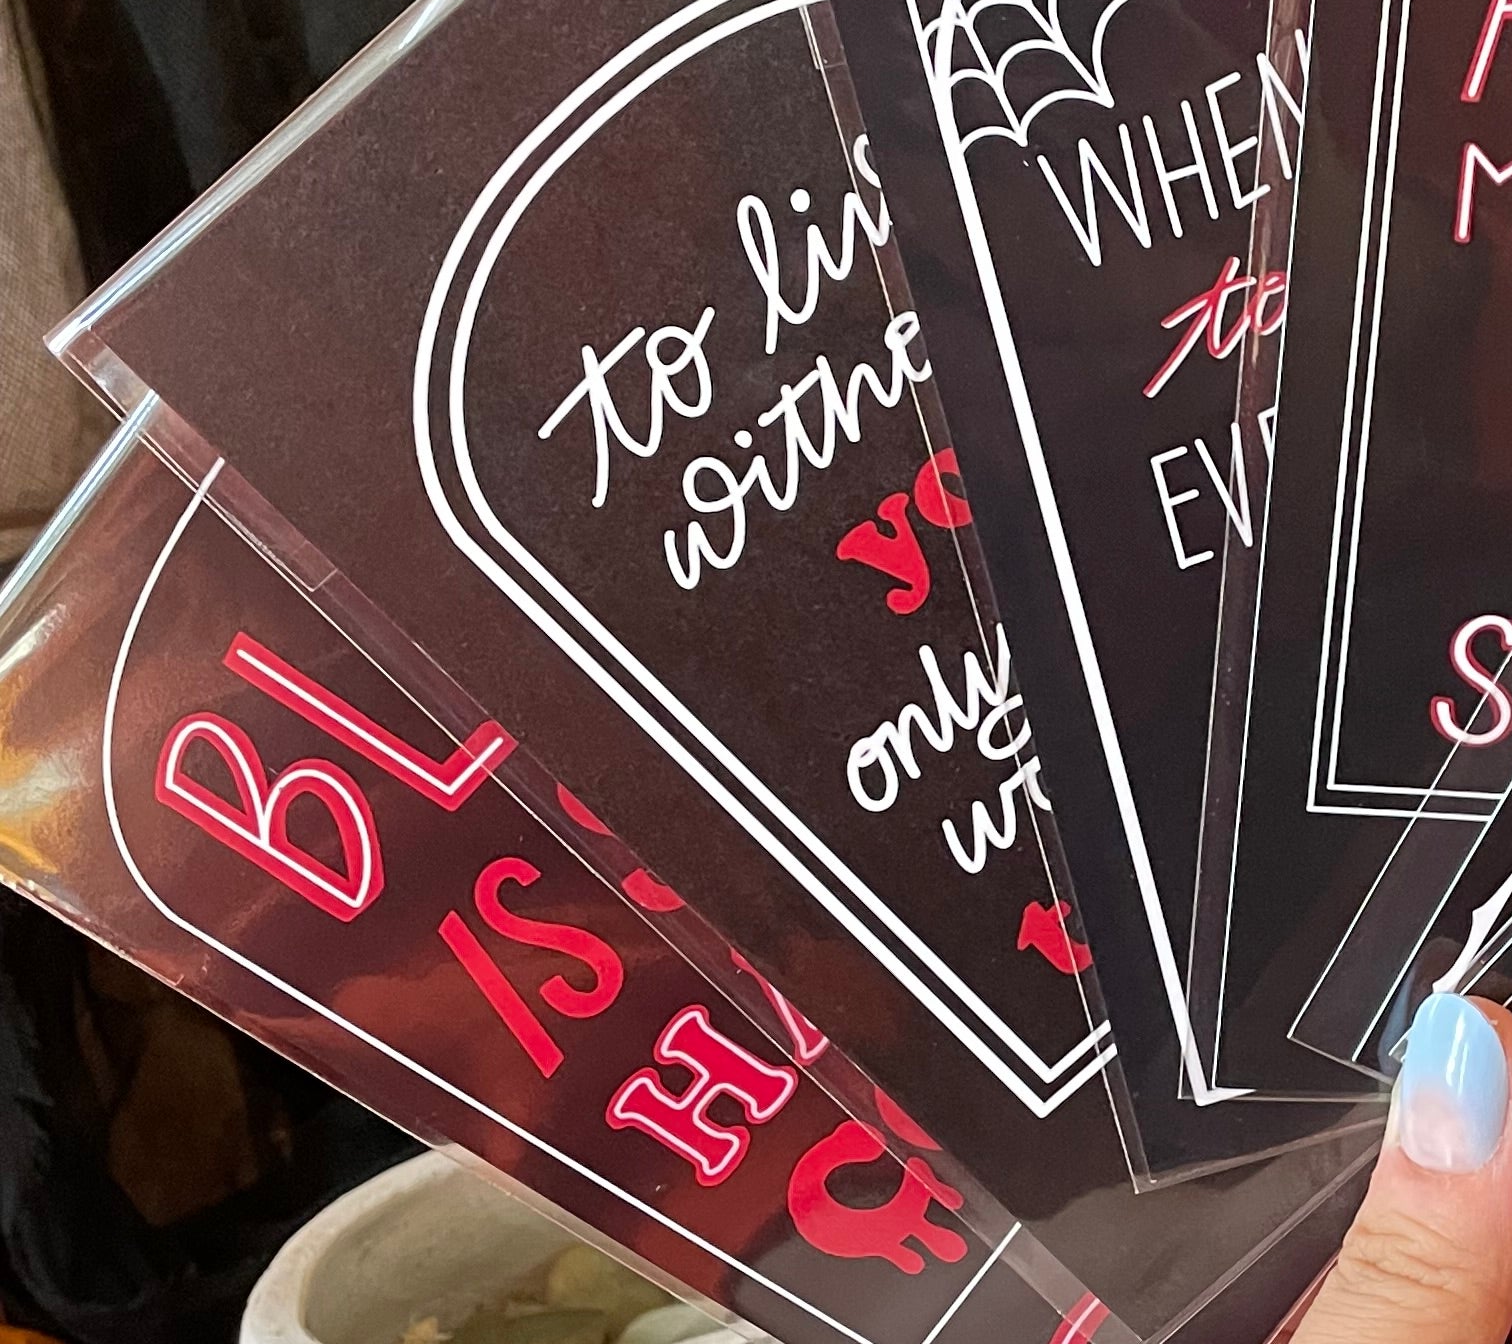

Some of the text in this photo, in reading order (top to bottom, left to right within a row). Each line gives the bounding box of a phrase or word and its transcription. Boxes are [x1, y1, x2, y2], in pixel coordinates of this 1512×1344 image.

[1037, 28, 1312, 267] WHEN
[539, 307, 716, 509] to
[154, 630, 516, 922] BL
[439, 857, 622, 1078] IS
